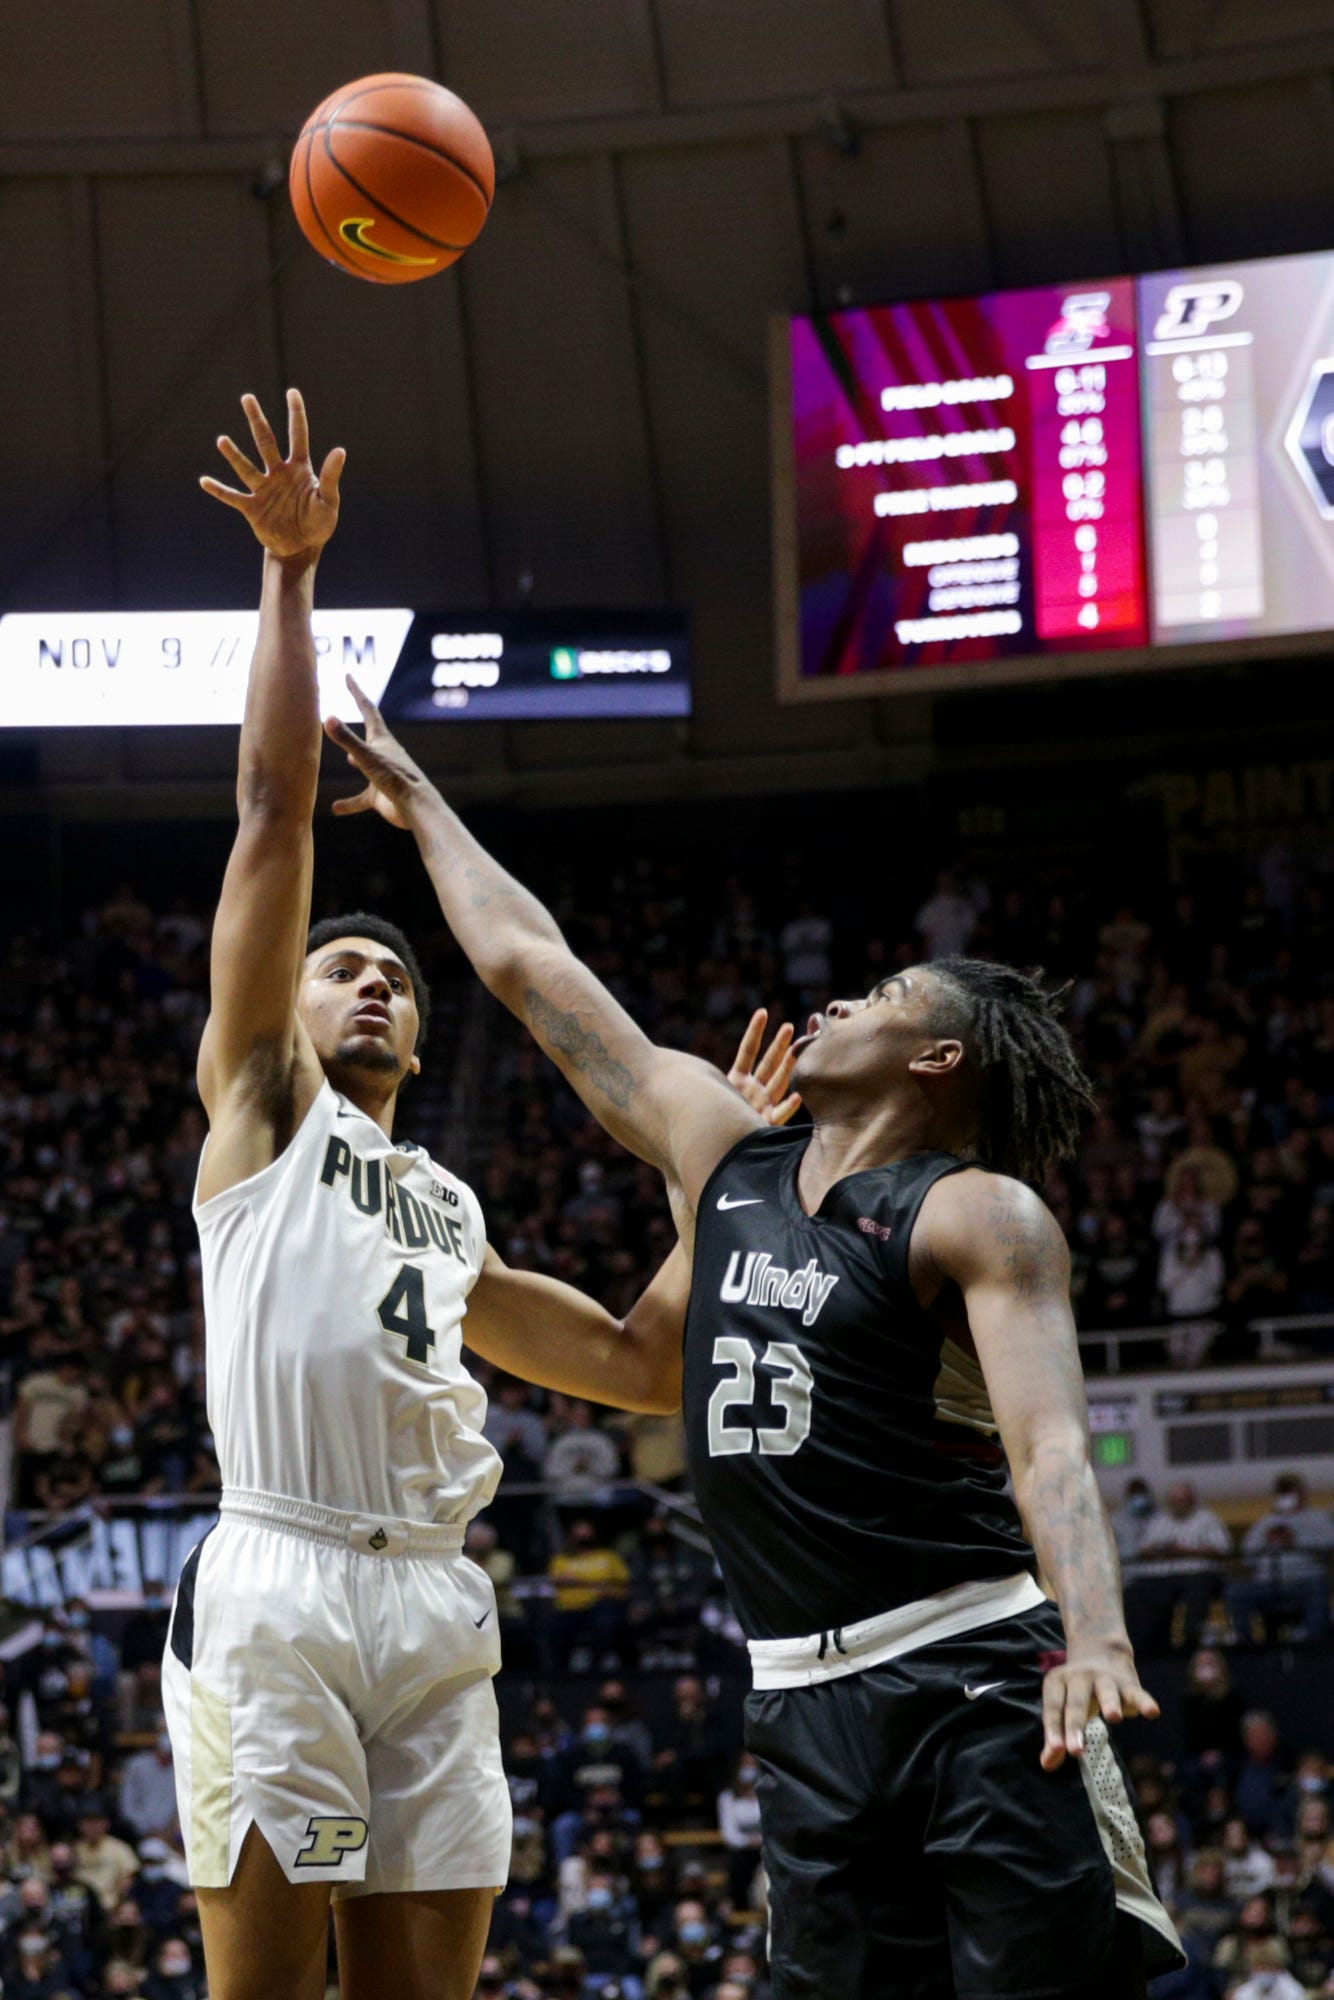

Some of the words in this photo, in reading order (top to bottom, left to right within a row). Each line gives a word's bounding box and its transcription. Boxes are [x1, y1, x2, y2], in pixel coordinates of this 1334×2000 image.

[39, 637, 121, 669] NOV
[161, 637, 181, 669] 9
[320, 1134, 468, 1266] PURDUE
[376, 1263, 436, 1368] 4
[720, 1250, 840, 1326] UIndy
[708, 1337, 814, 1457] 23
[294, 1816, 369, 1868] P
